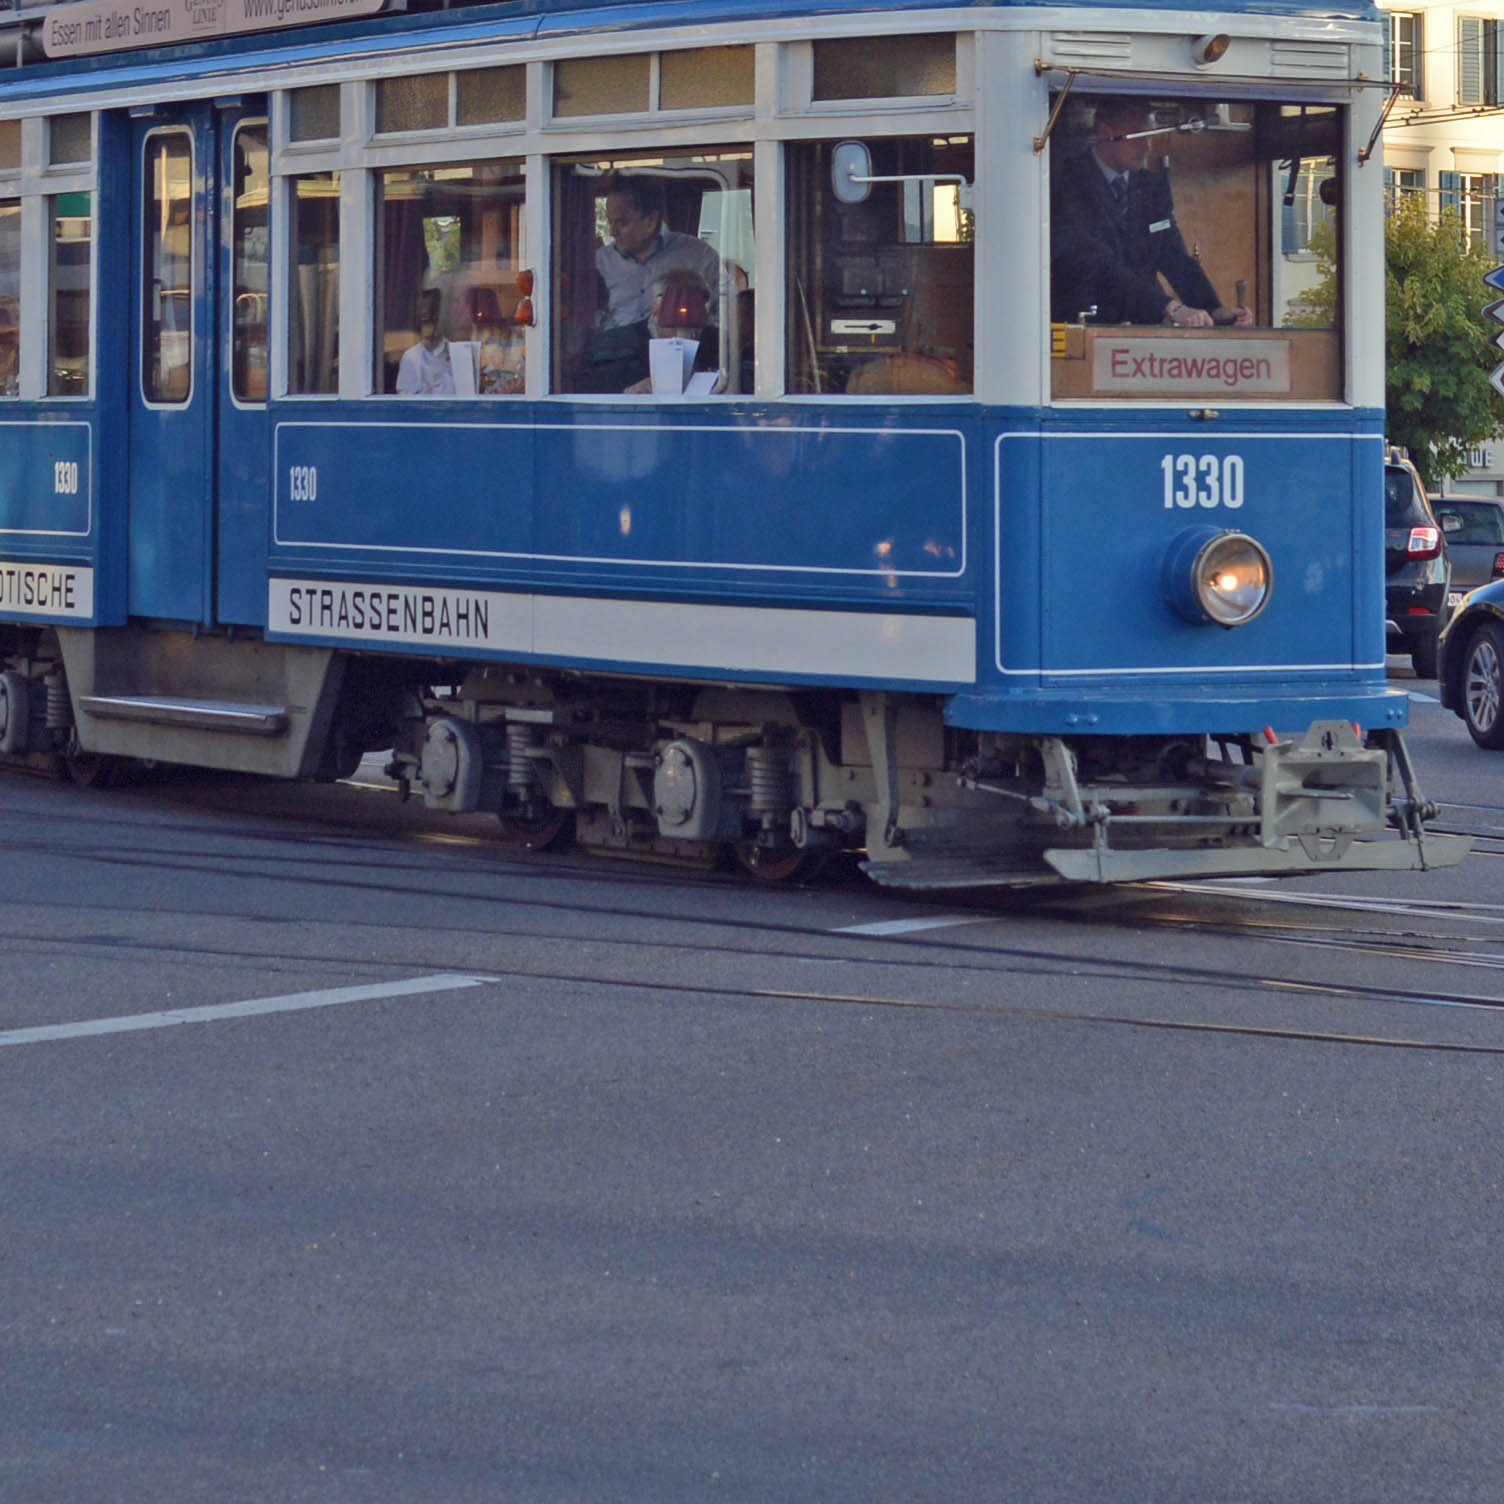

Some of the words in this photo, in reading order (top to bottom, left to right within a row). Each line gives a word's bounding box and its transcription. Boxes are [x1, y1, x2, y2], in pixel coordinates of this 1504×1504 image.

[51, 17, 83, 47] Essen
[84, 13, 103, 41] mit
[103, 8, 132, 38] allen
[133, 4, 171, 35] Sinnen
[1110, 348, 1272, 386] Extrawagen
[54, 461, 77, 494] 1330
[290, 466, 316, 501] 1330
[1161, 454, 1244, 509] 1330
[289, 587, 489, 639] STRASSENBAHN
